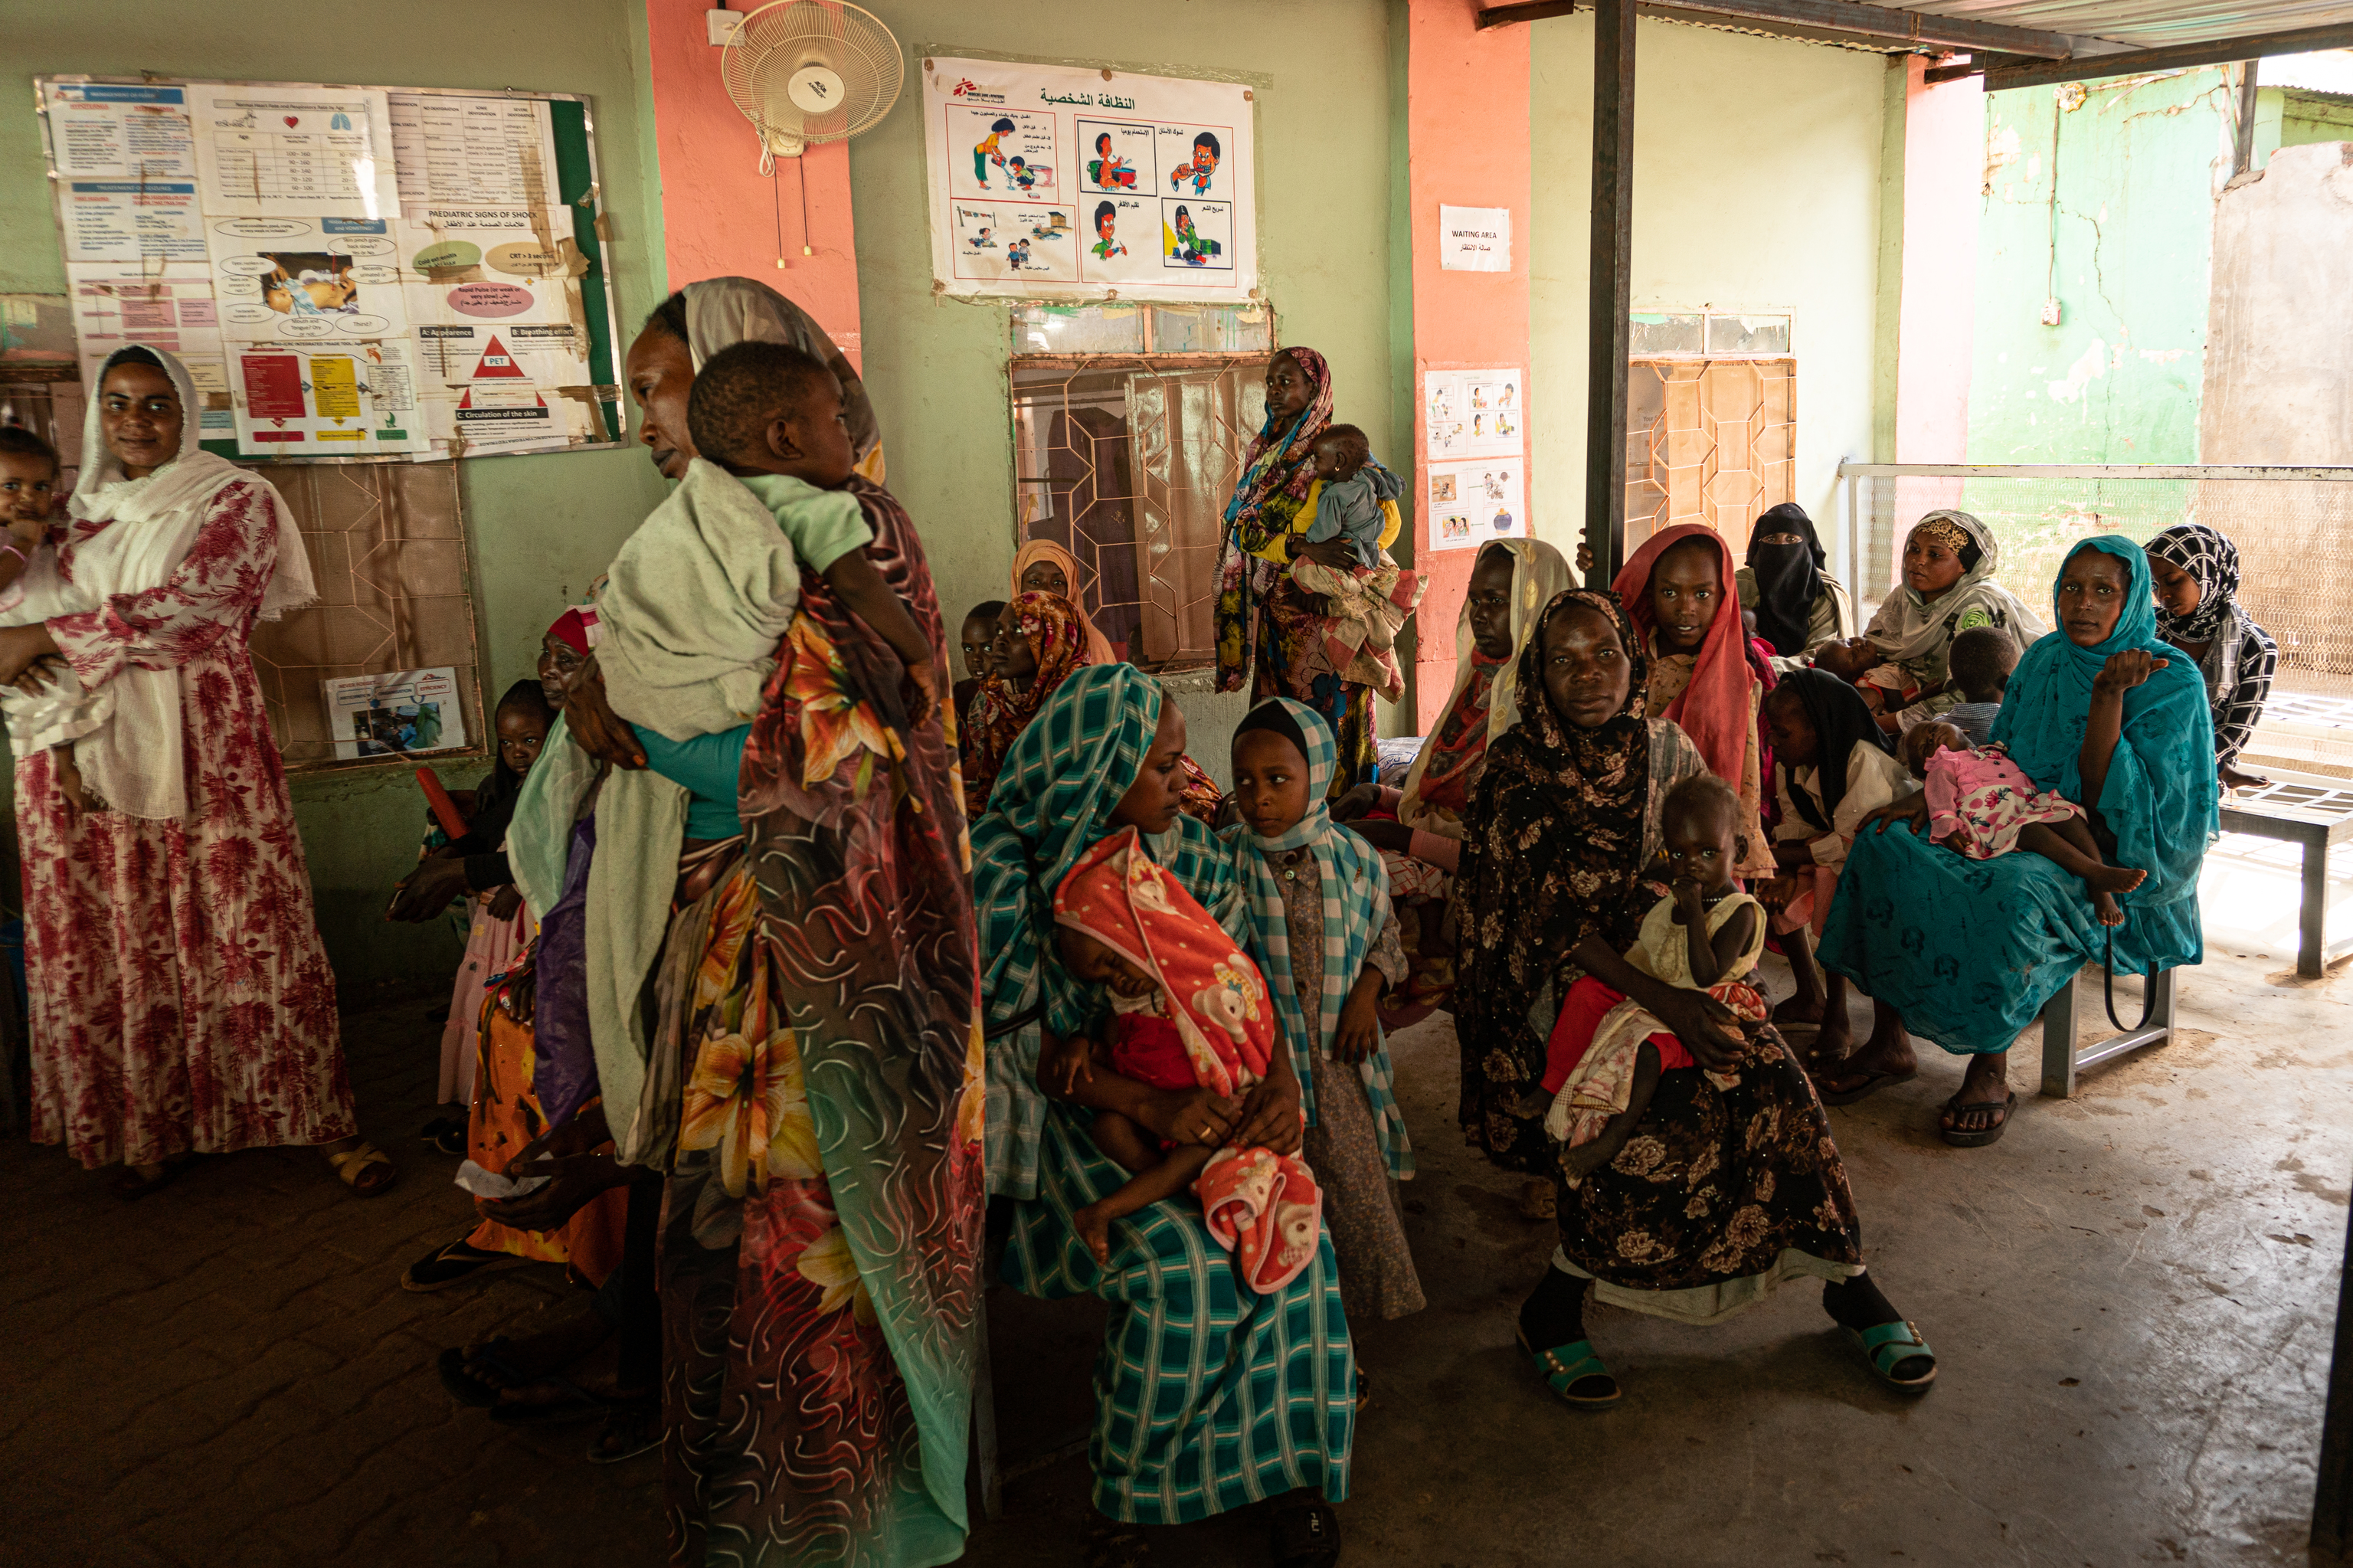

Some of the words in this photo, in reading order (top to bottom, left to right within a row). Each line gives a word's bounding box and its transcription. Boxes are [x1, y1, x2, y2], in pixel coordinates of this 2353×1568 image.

[1040, 87, 1094, 106] الشخصية
[1098, 93, 1135, 110] النظافة
[428, 210, 473, 218] PAEDIATRIC
[1451, 230, 1480, 239] WAITING
[1478, 243, 1491, 251] صالة
[417, 257, 430, 266] Cold
